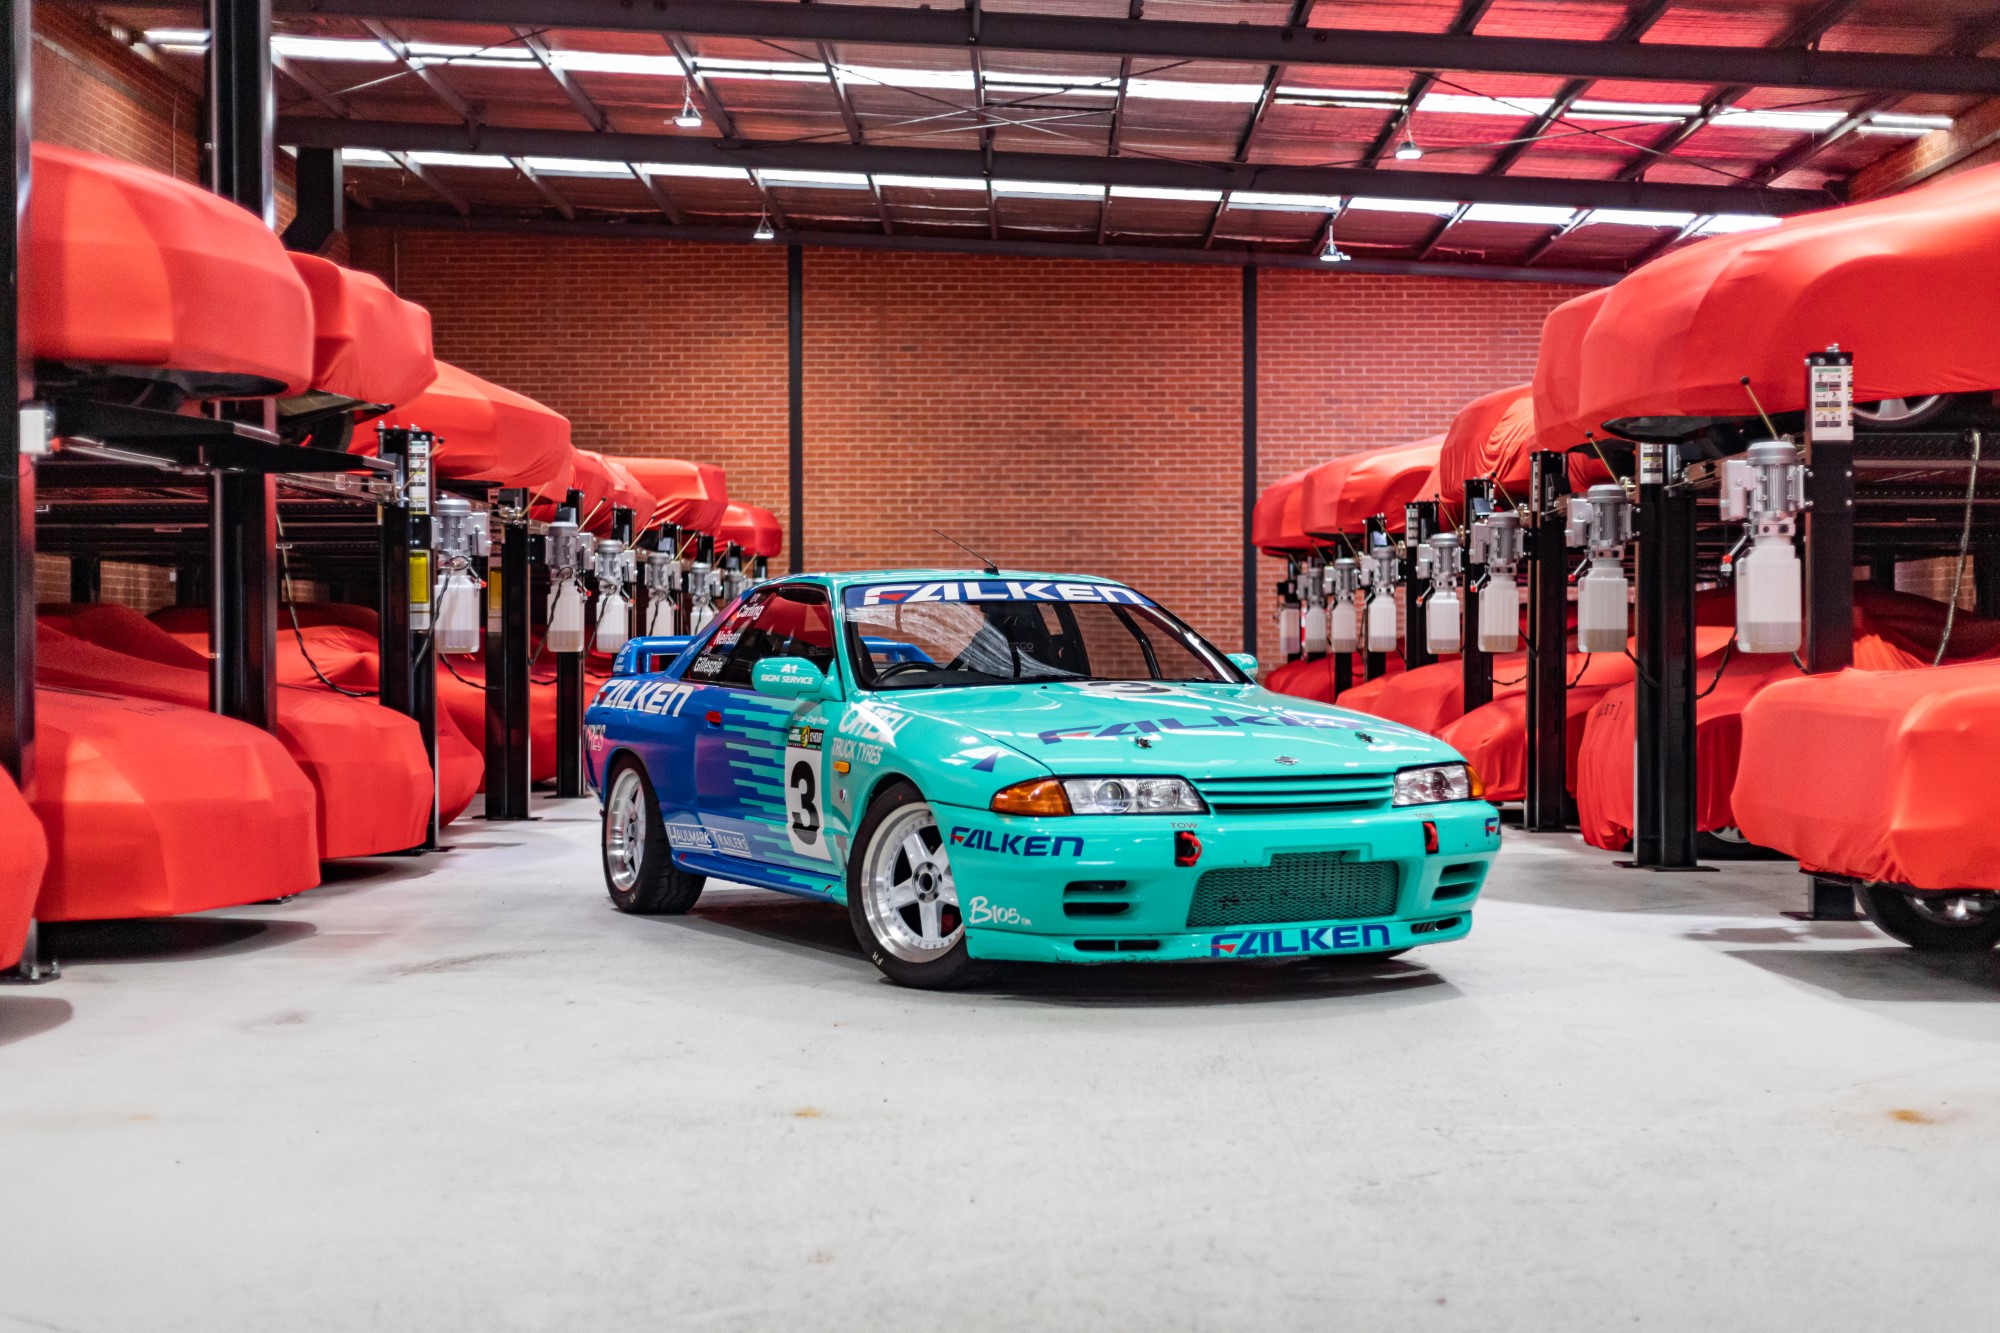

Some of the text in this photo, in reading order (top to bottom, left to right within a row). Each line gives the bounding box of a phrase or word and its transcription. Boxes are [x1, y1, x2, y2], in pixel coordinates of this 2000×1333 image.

[863, 582, 1144, 605] FALKEN
[761, 674, 814, 684] SIGN SERVICE
[781, 664, 798, 673] A1
[592, 680, 694, 717] FALKEN
[832, 738, 883, 765] TRUCK TYRES
[791, 761, 819, 845] 3
[949, 826, 1084, 857] FALKEN
[969, 896, 1020, 924] B105
[1208, 924, 1390, 957] FALKEN
